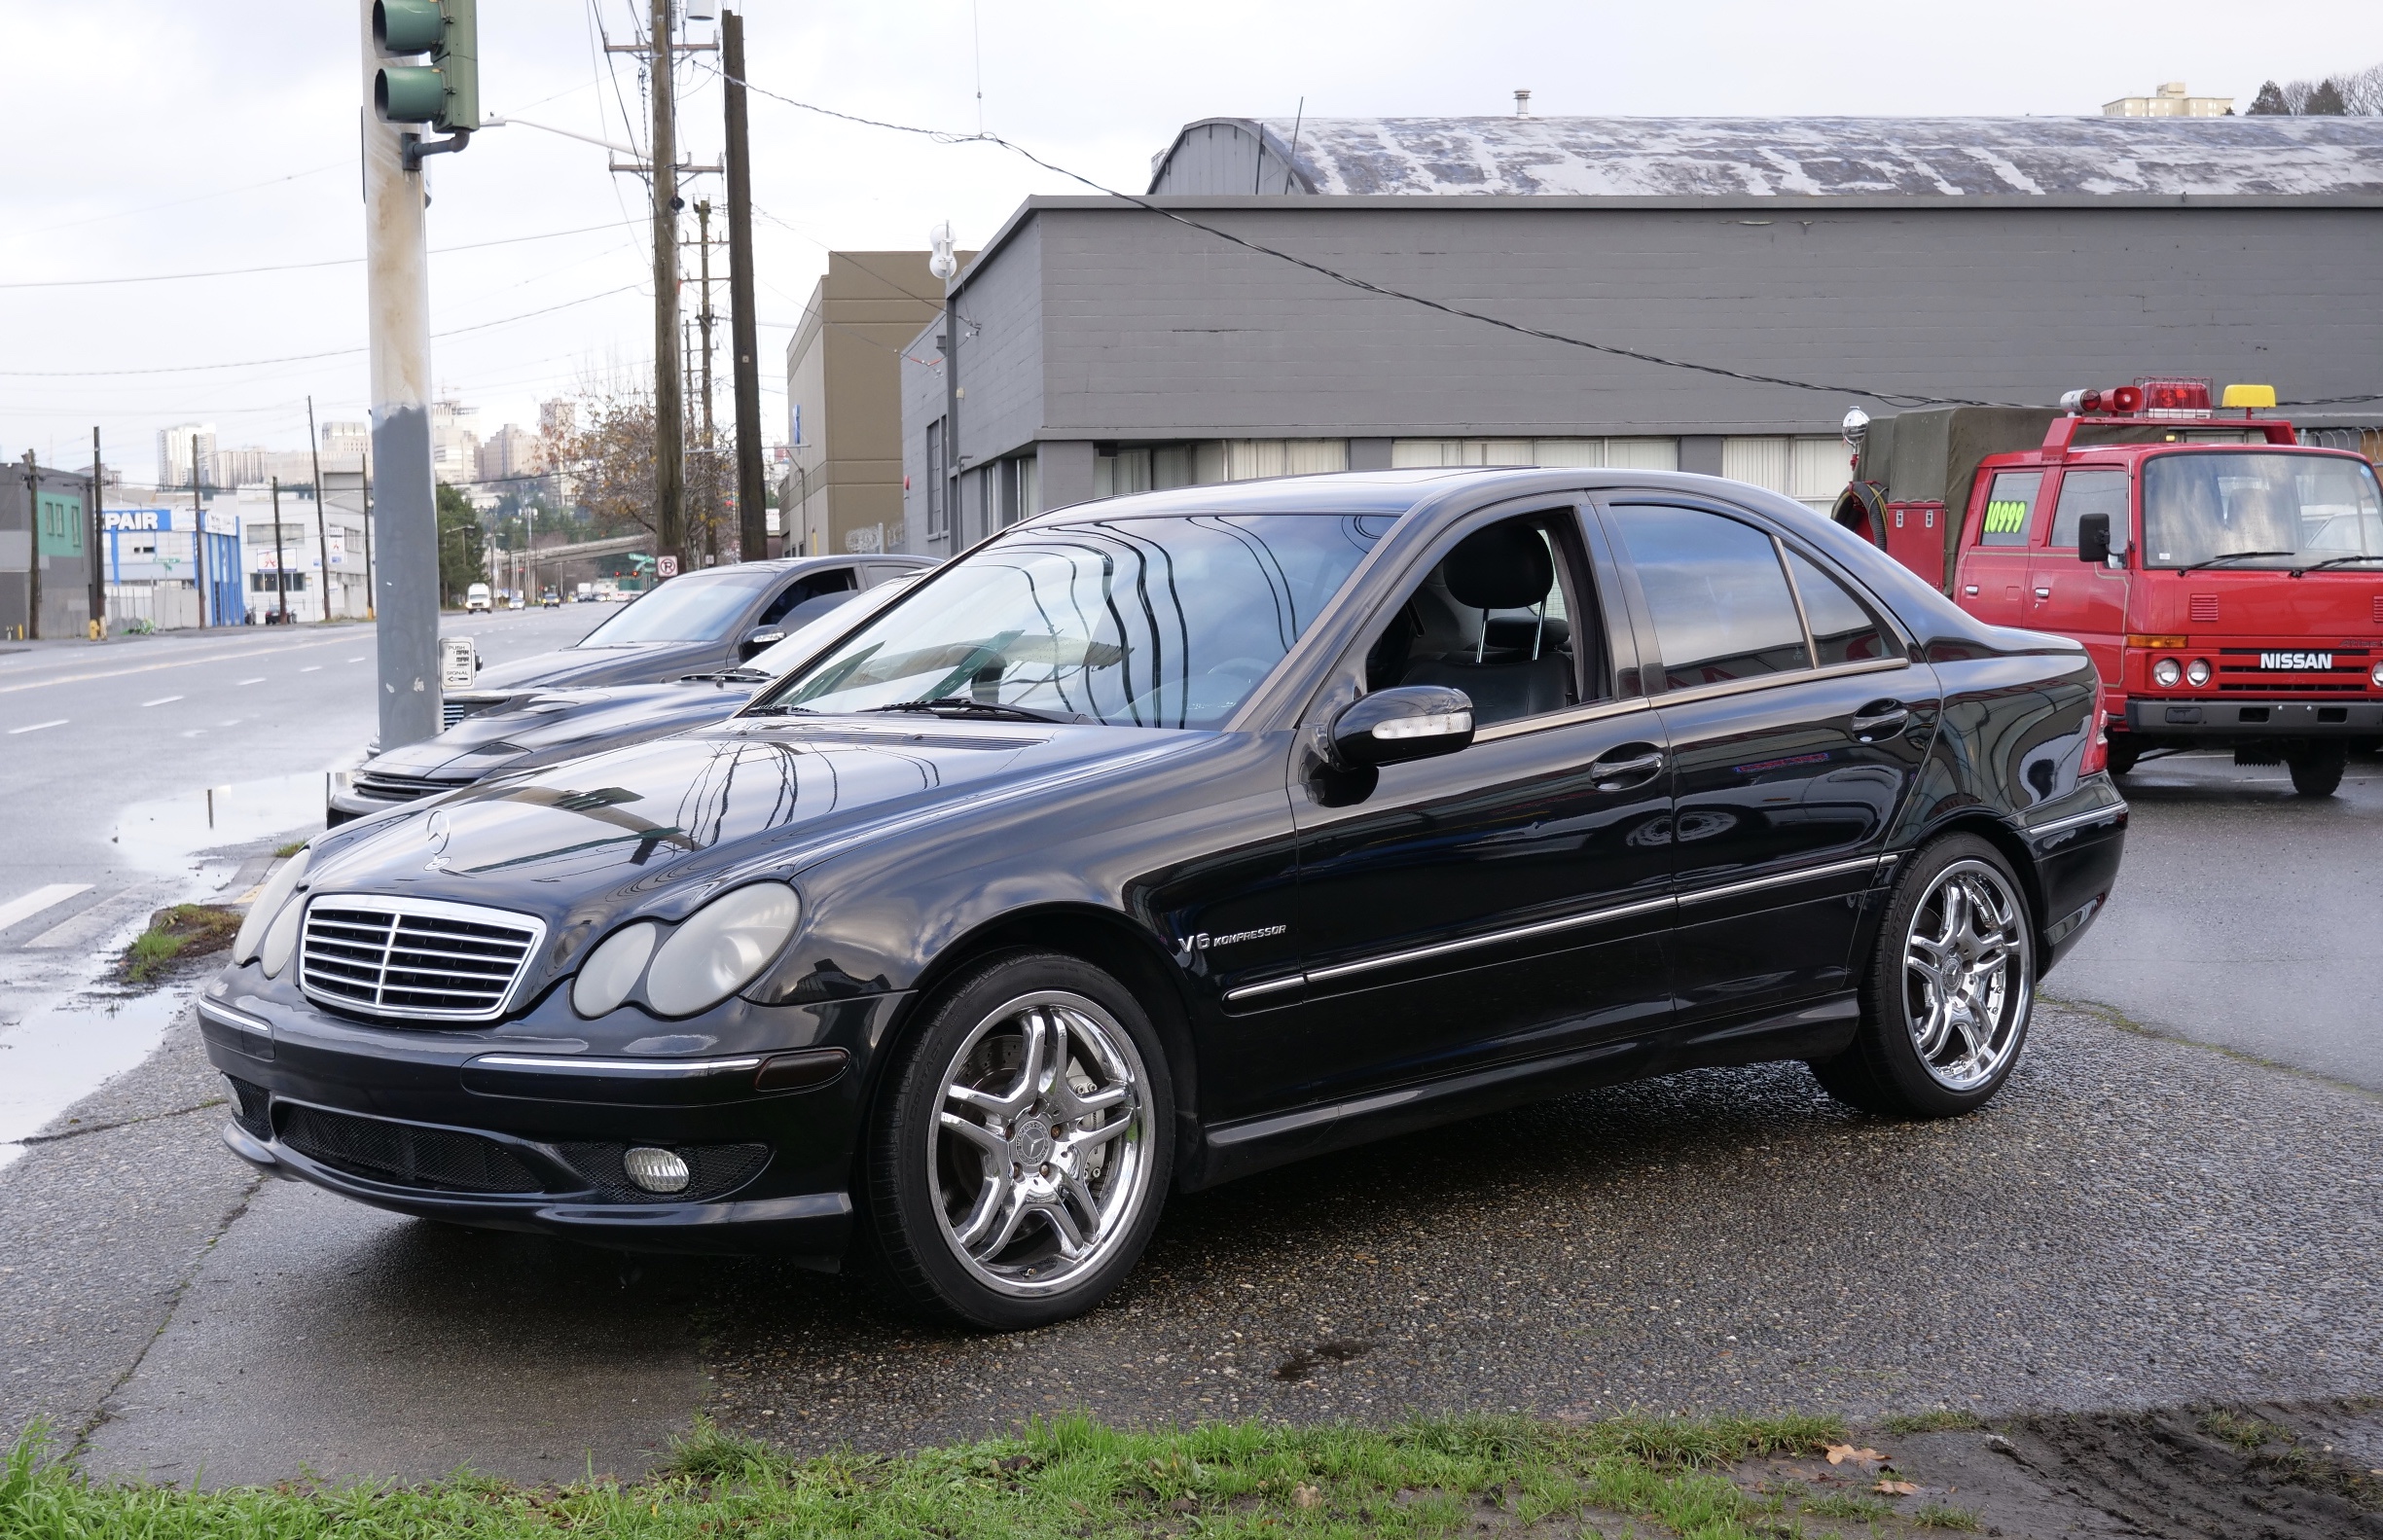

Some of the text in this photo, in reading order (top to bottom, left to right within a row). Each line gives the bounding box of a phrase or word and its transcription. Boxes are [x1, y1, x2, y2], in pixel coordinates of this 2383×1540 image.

[1984, 501, 2026, 533] 10999
[2260, 653, 2332, 669] NISSAN
[1177, 924, 1287, 953] V6 KOMPRESSOR
